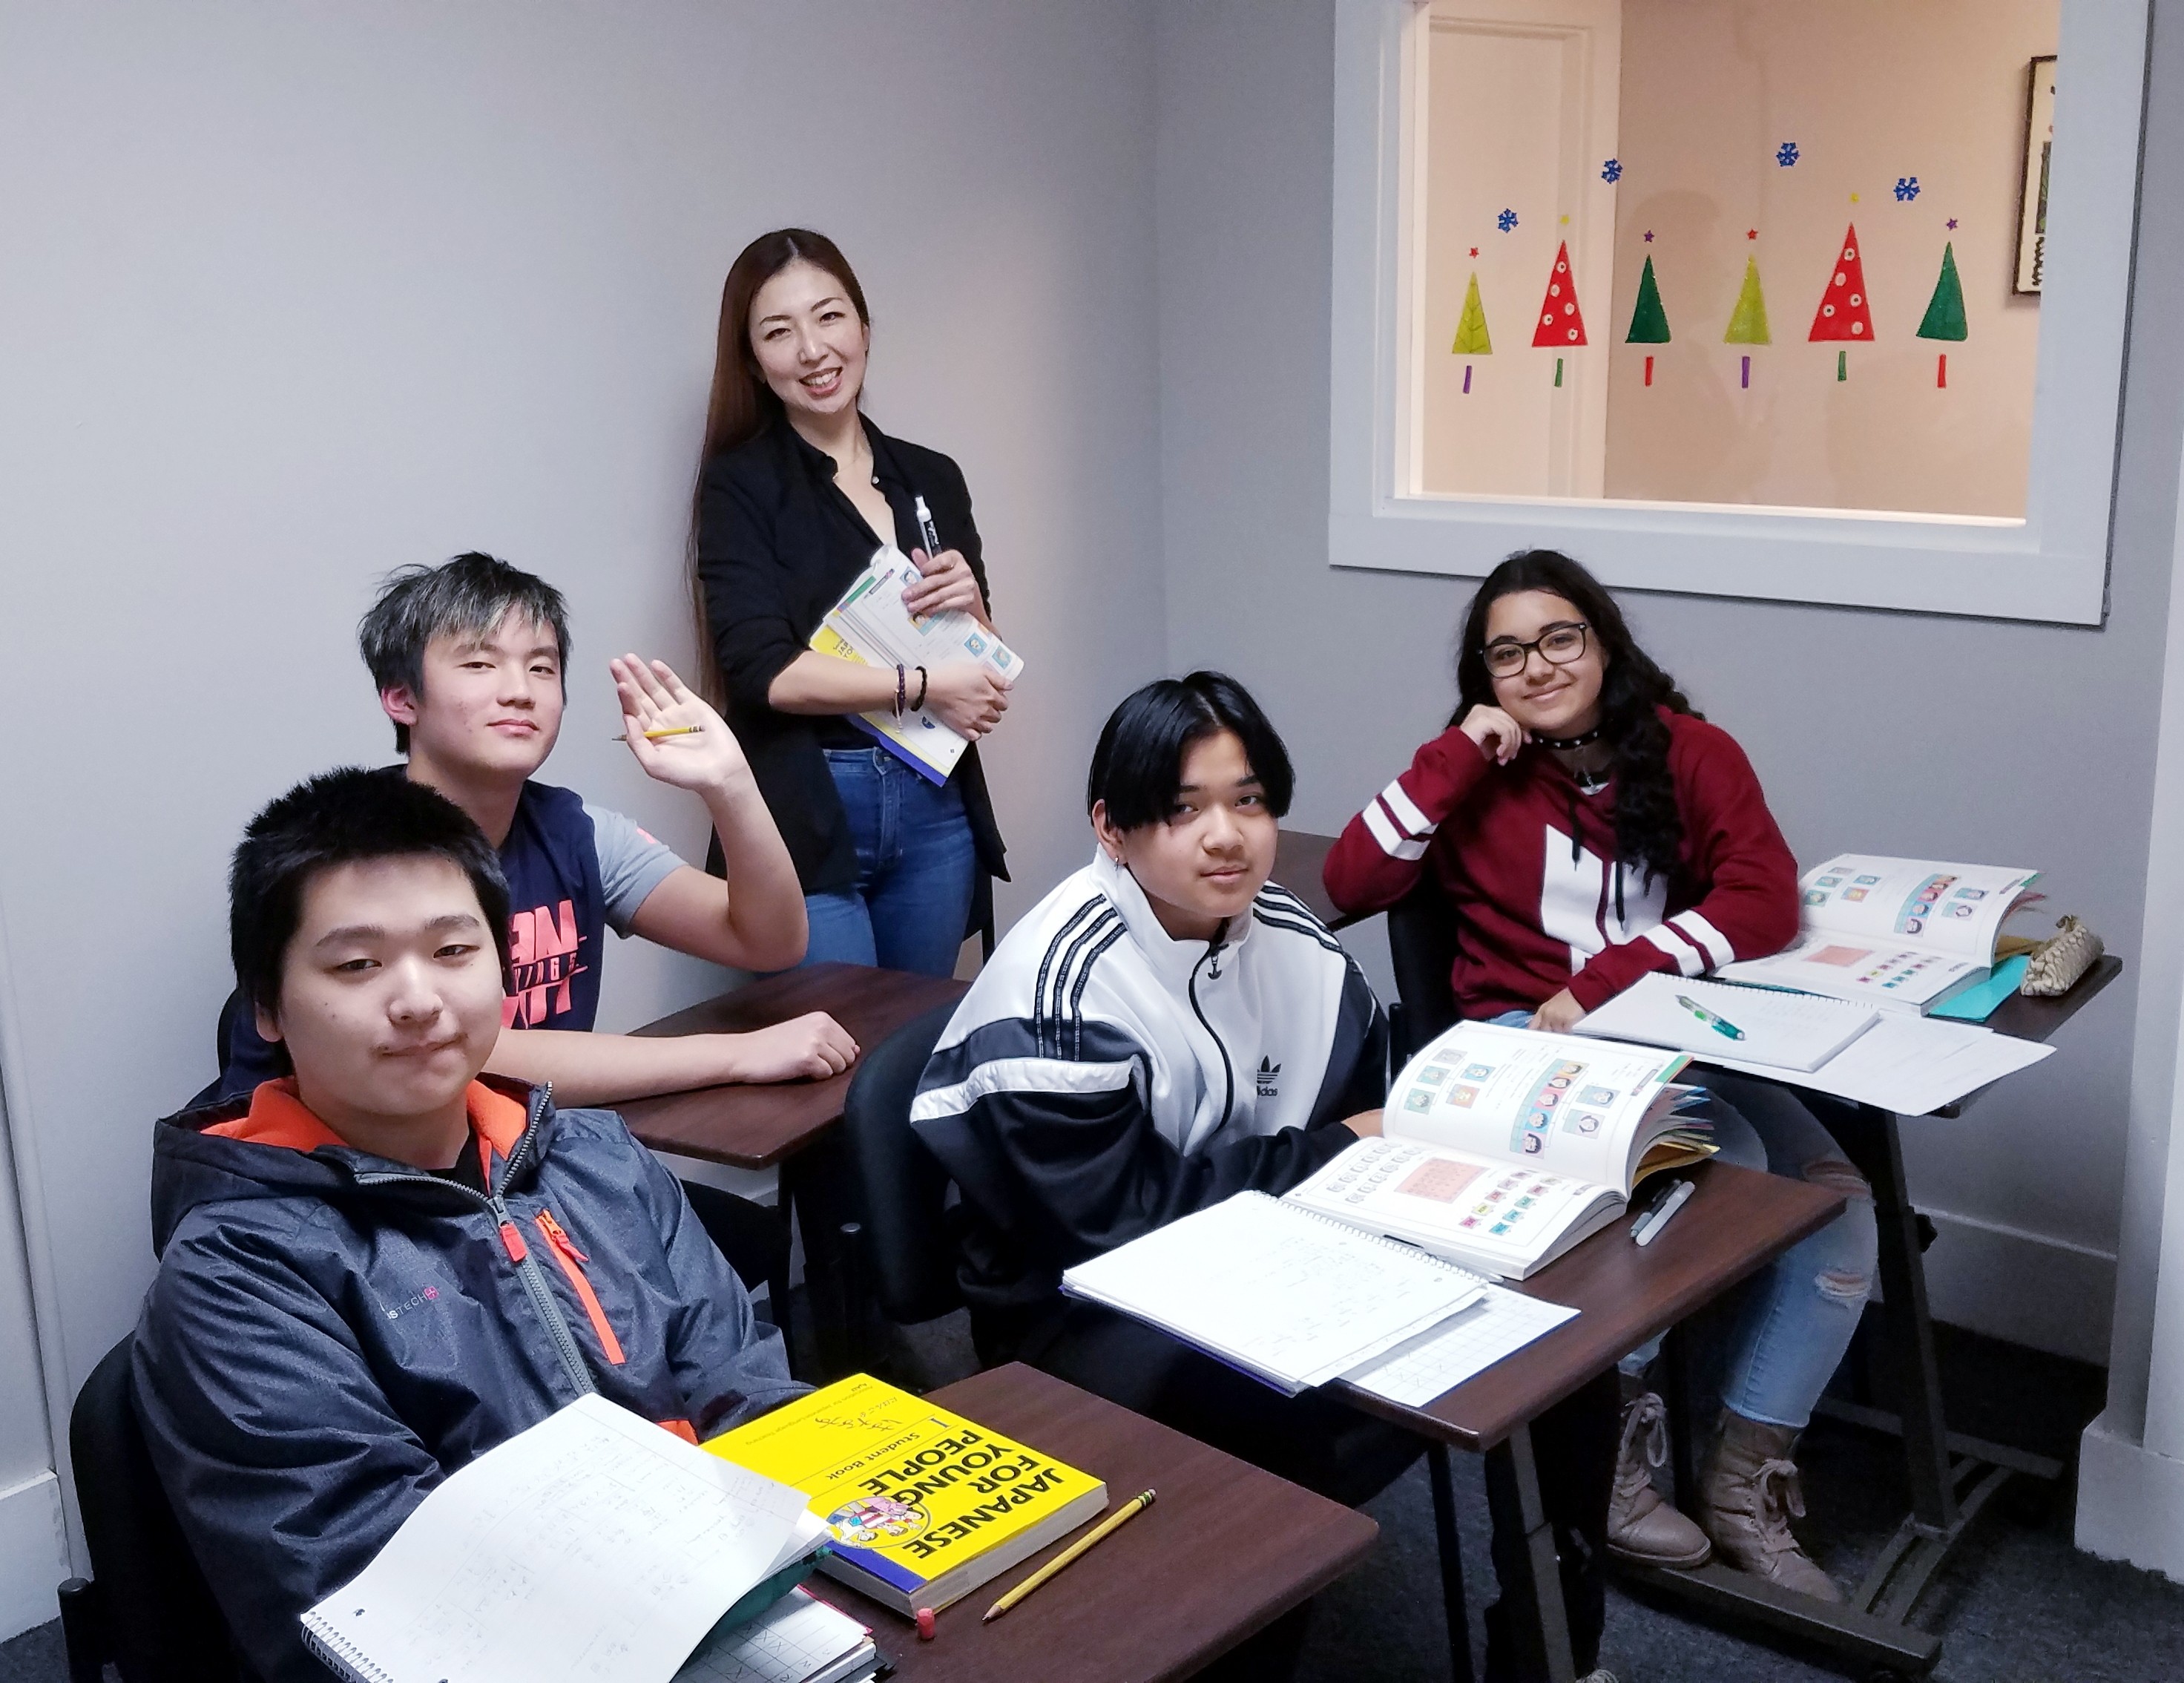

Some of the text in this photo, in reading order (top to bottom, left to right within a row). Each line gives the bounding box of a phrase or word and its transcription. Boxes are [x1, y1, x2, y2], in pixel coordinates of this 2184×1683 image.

[827, 1432, 921, 1480] Student Book
[858, 1429, 984, 1497] PEOPLE
[890, 1443, 1015, 1507] YOUNG
[967, 1455, 1042, 1494] FOR
[902, 1467, 1065, 1559] JAPANESE
